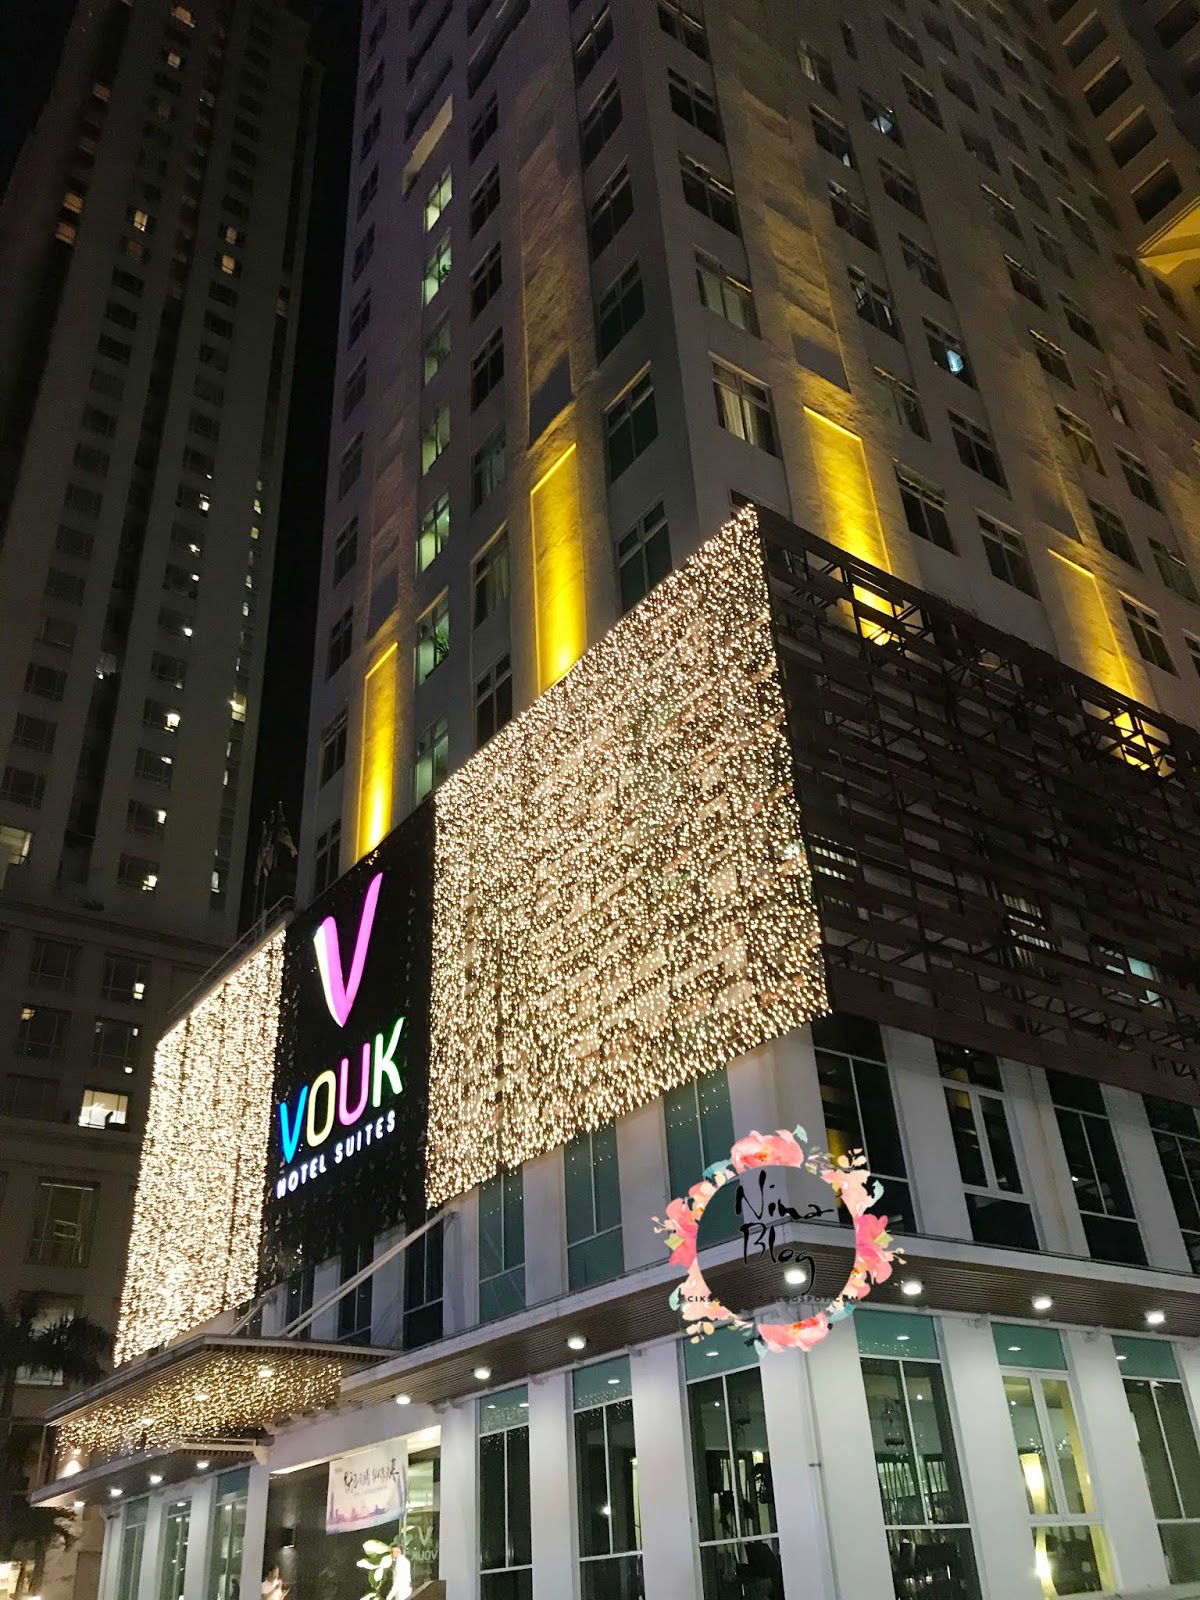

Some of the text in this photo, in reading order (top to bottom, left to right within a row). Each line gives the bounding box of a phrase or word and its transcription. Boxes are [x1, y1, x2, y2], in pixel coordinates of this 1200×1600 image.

[279, 1016, 406, 1164] VOUK
[276, 1109, 397, 1199] HOTEL SUITES
